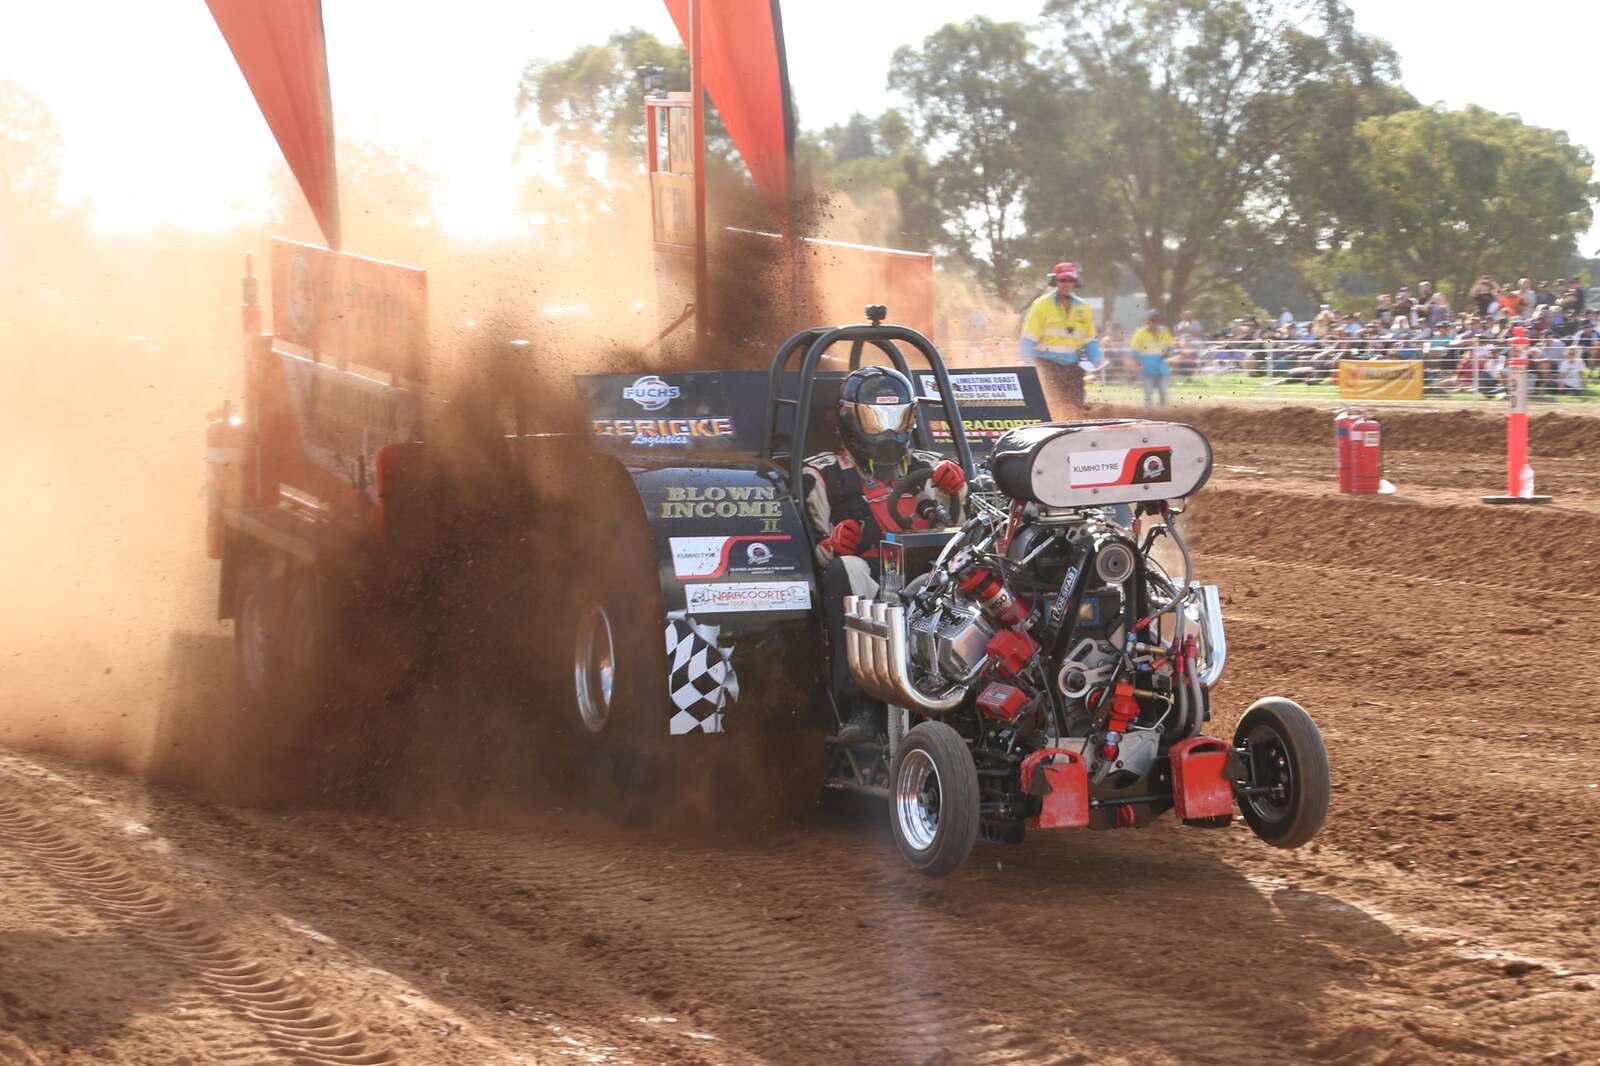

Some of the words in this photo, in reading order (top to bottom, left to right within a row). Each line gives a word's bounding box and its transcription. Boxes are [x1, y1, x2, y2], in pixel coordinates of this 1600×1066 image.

[626, 388, 678, 398] FUCHS
[592, 416, 734, 437] GERICKE
[631, 432, 688, 447] Logistics
[1074, 465, 1100, 473] KUMHO
[1102, 463, 1119, 471] TYRE
[665, 486, 777, 501] BLOWN
[660, 501, 783, 518] INCOME
[762, 518, 779, 531] II
[712, 590, 786, 603] NARACOORTE
